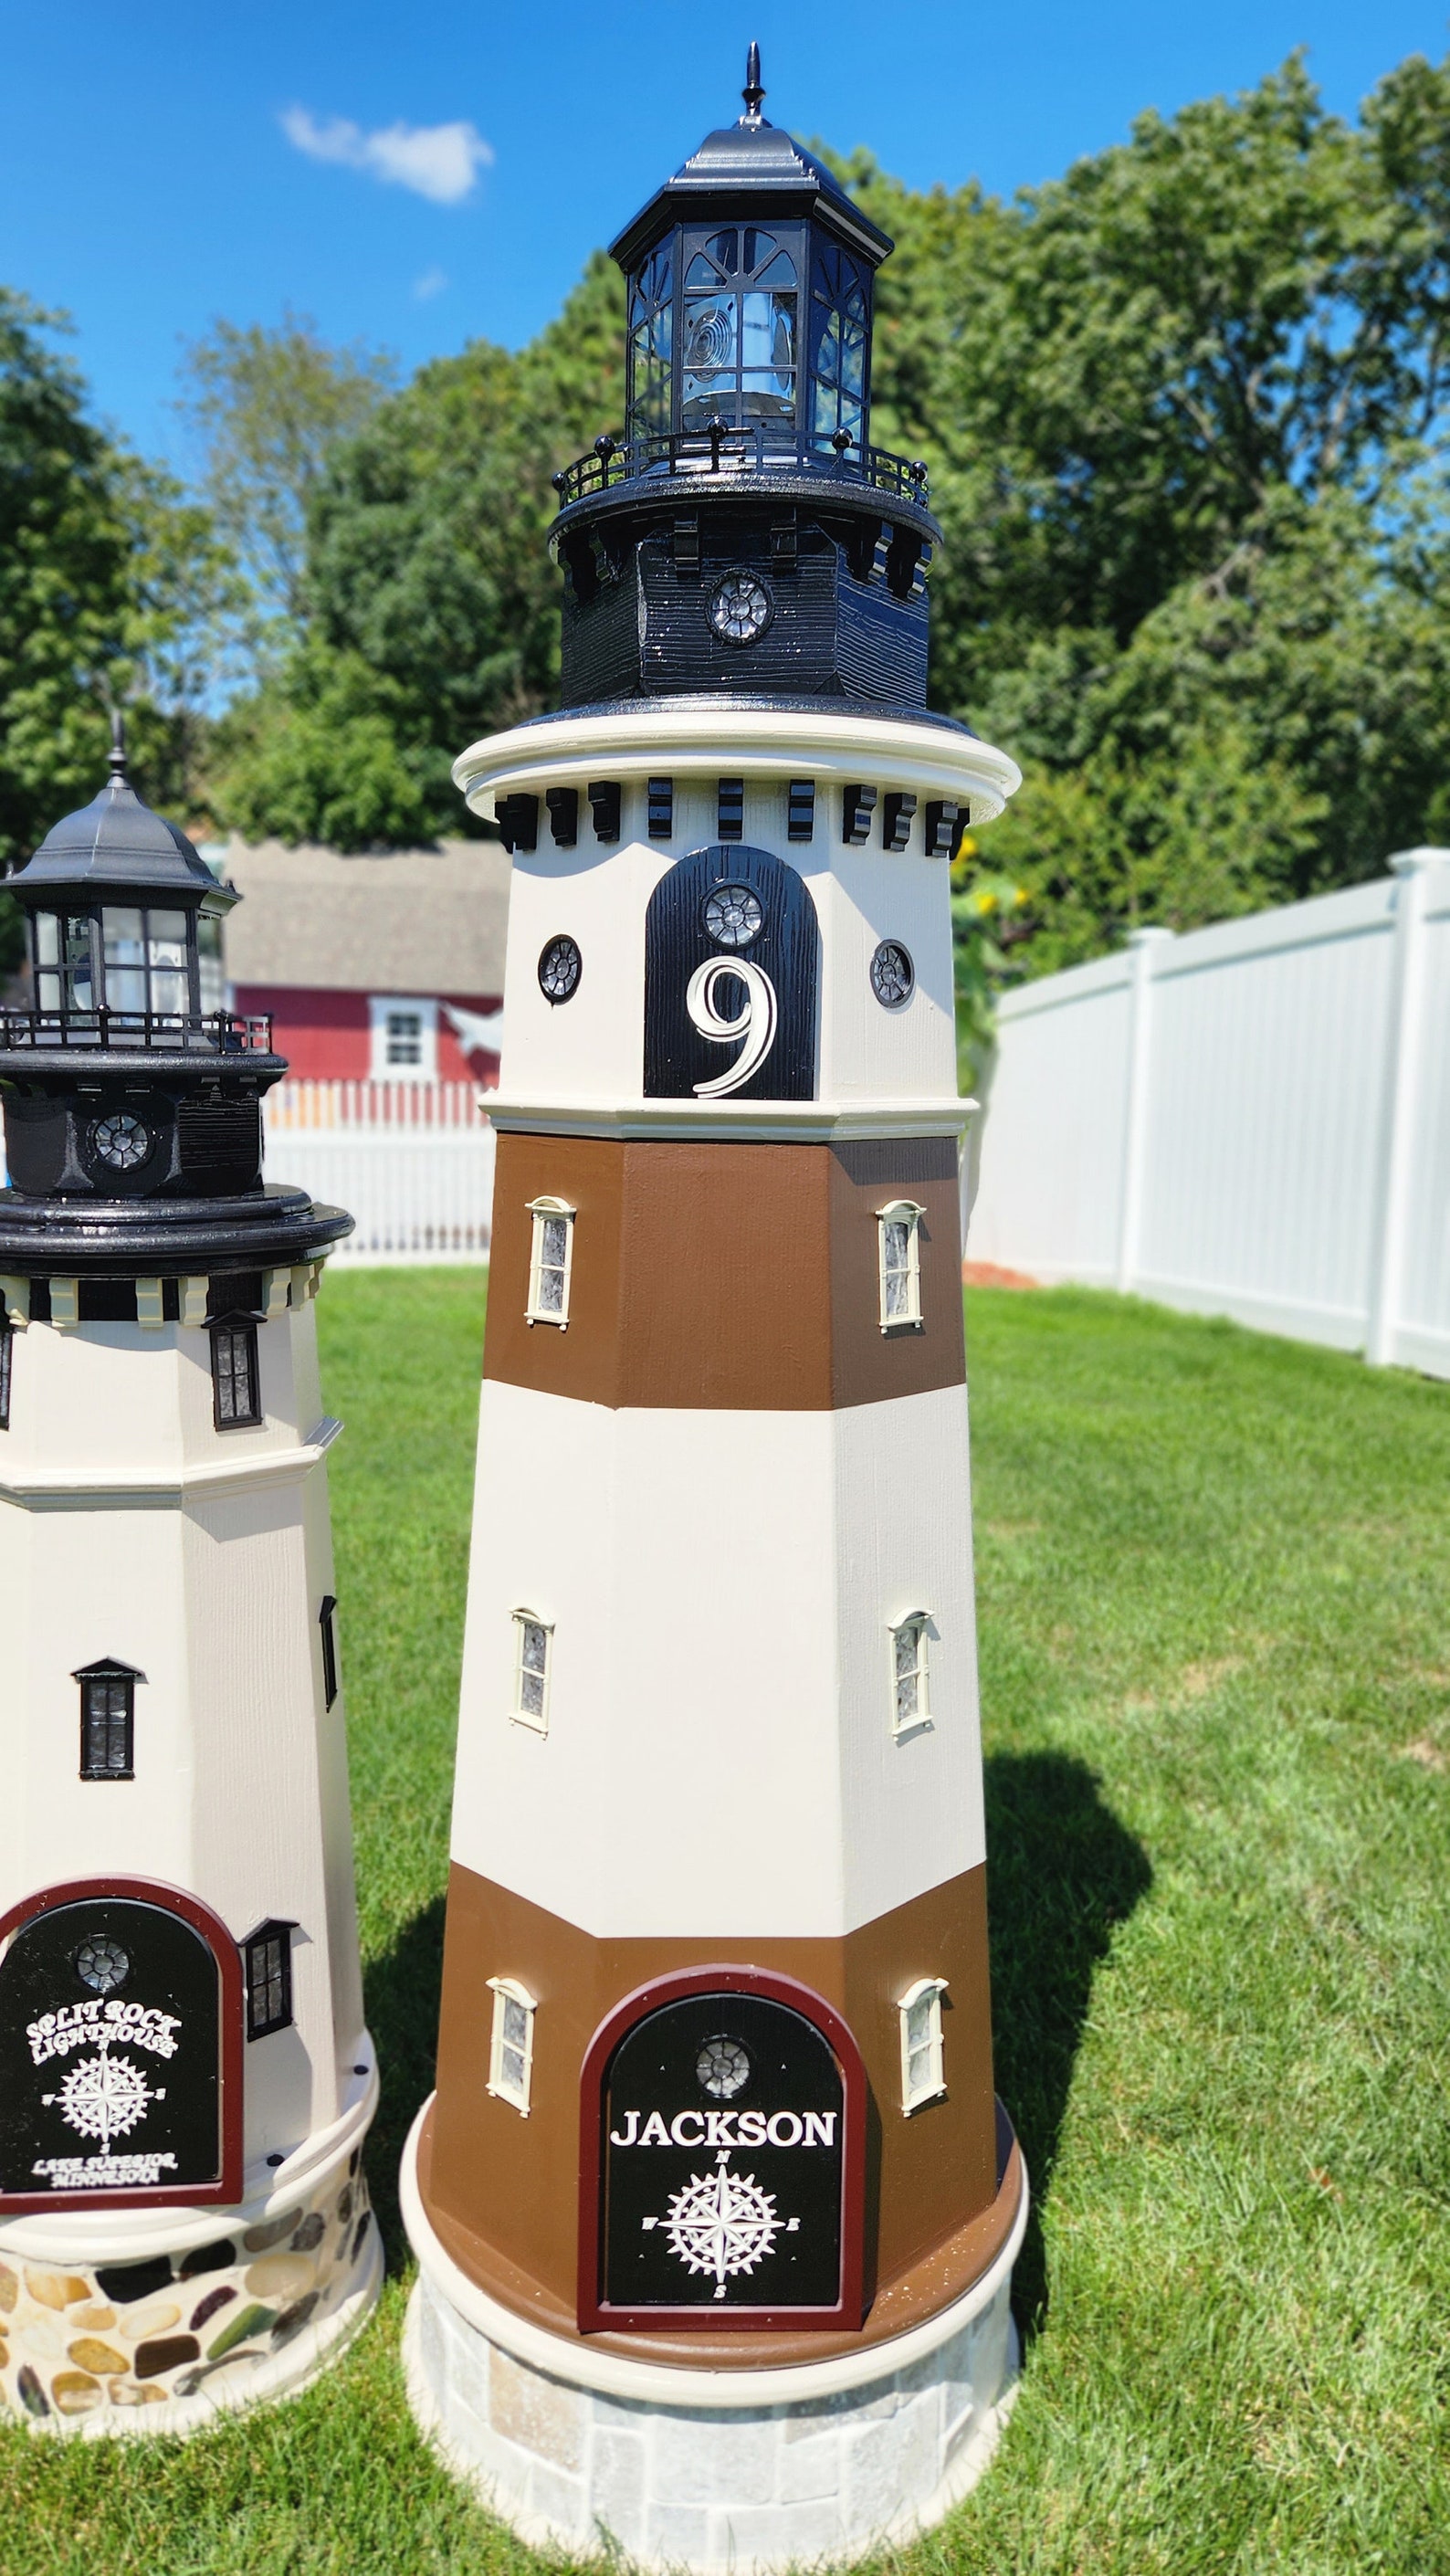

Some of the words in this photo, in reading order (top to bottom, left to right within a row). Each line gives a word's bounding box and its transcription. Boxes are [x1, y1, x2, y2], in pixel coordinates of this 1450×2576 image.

[687, 955, 777, 1099] 9
[26, 1998, 104, 2046] SPLIT
[104, 2000, 183, 2041] ROCK
[31, 2022, 179, 2066] LIGHTHOUSE
[610, 2110, 837, 2146] JACKSON
[714, 2150, 731, 2163] N
[31, 2158, 87, 2174] LAKE
[51, 2168, 161, 2188] MINNESOTA
[641, 2216, 659, 2230] W
[785, 2217, 801, 2231] E
[713, 2285, 727, 2298] S
